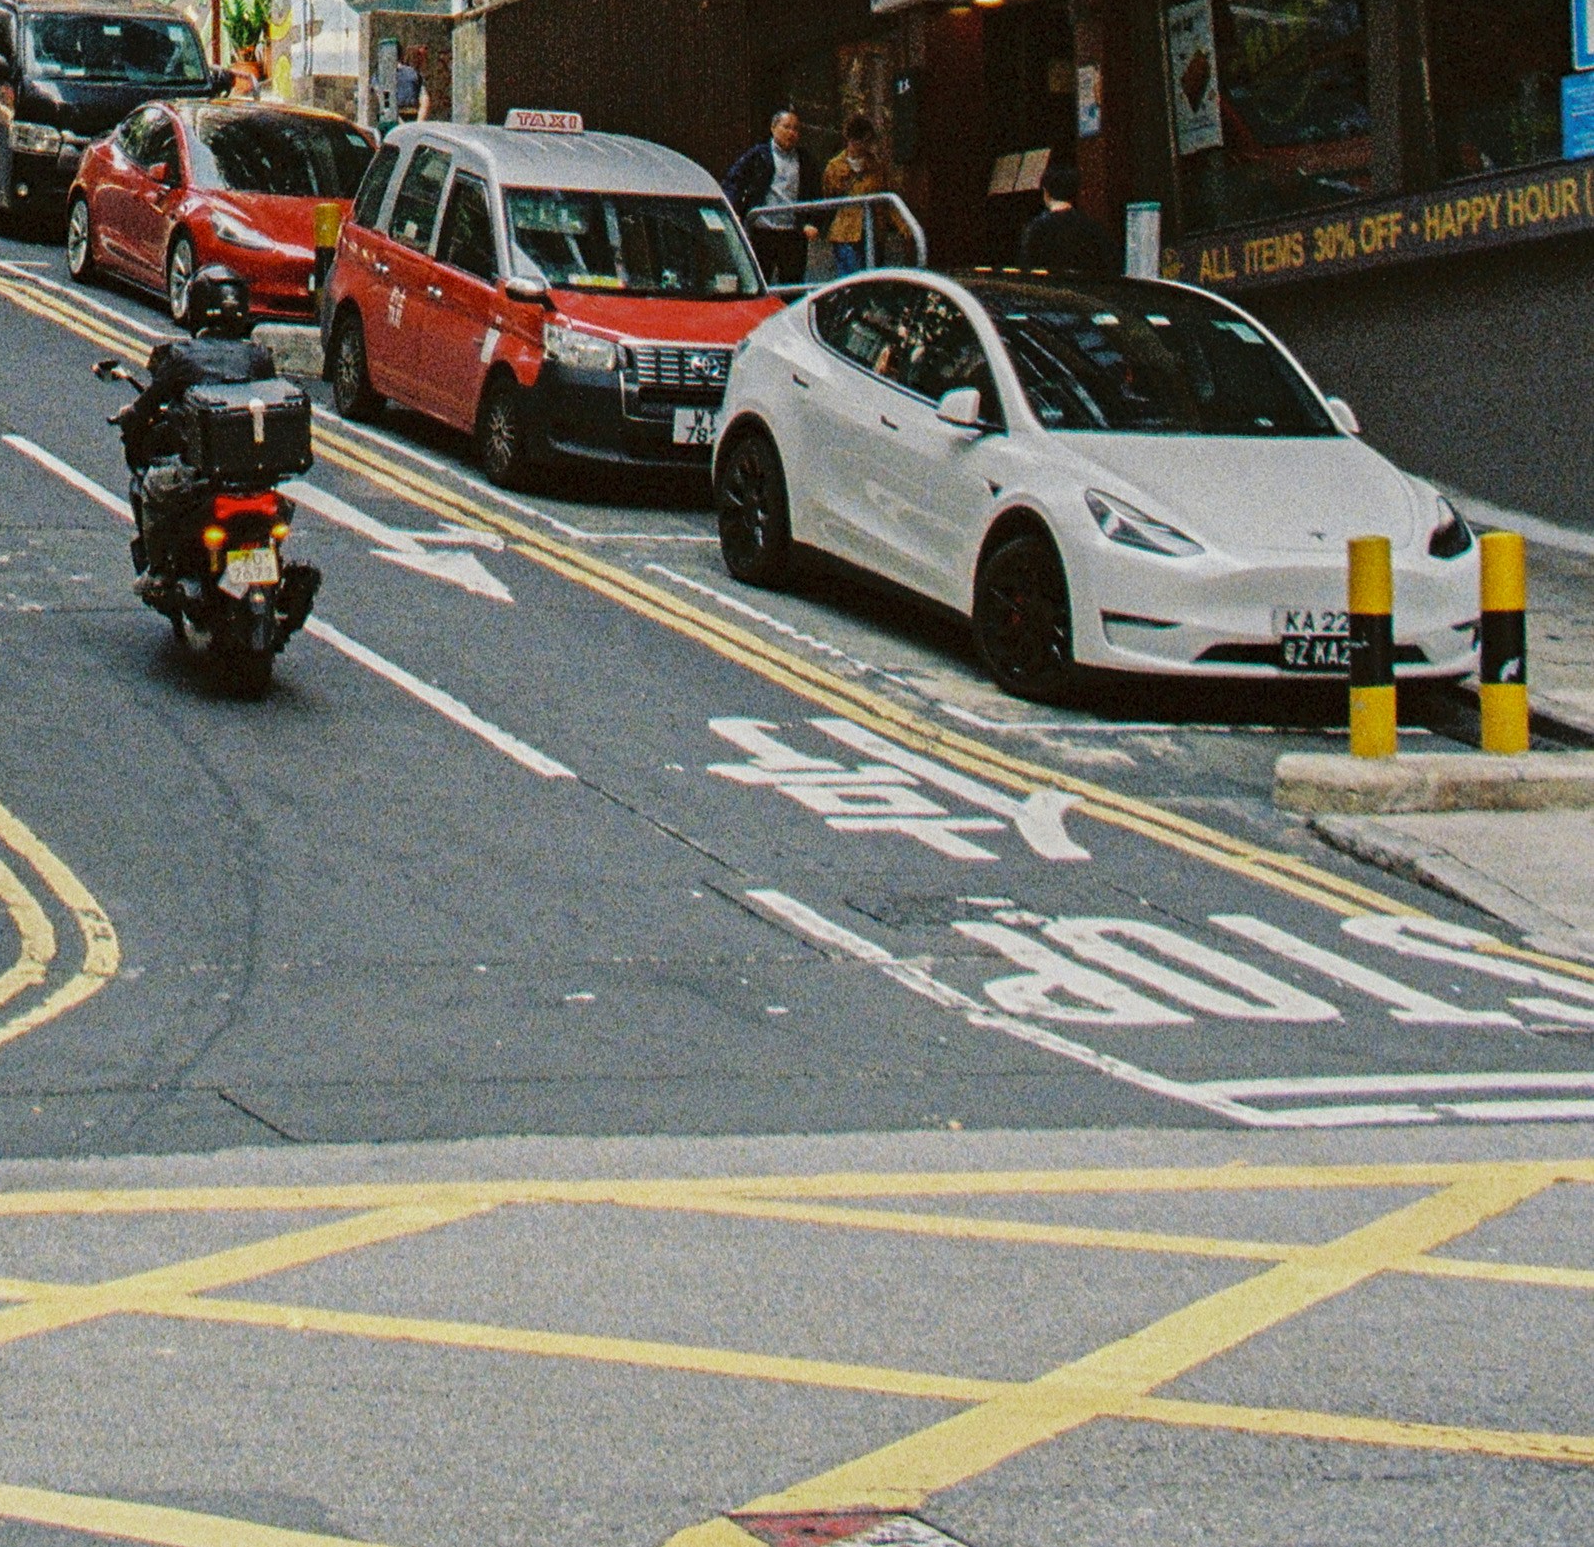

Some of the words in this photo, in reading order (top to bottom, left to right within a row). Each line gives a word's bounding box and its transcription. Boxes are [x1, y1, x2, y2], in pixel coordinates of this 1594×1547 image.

[516, 111, 578, 129] TAXI
[1199, 245, 1237, 283] ALL
[1242, 232, 1305, 275] ITEMS
[1313, 221, 1357, 262] 30%
[1359, 211, 1404, 254] OFF
[1424, 193, 1502, 242] HAPPY
[1508, 177, 1580, 226] HOUR
[1286, 611, 1316, 633] KA
[1321, 610, 1351, 633] 22
[951, 912, 1594, 1032] STOP
